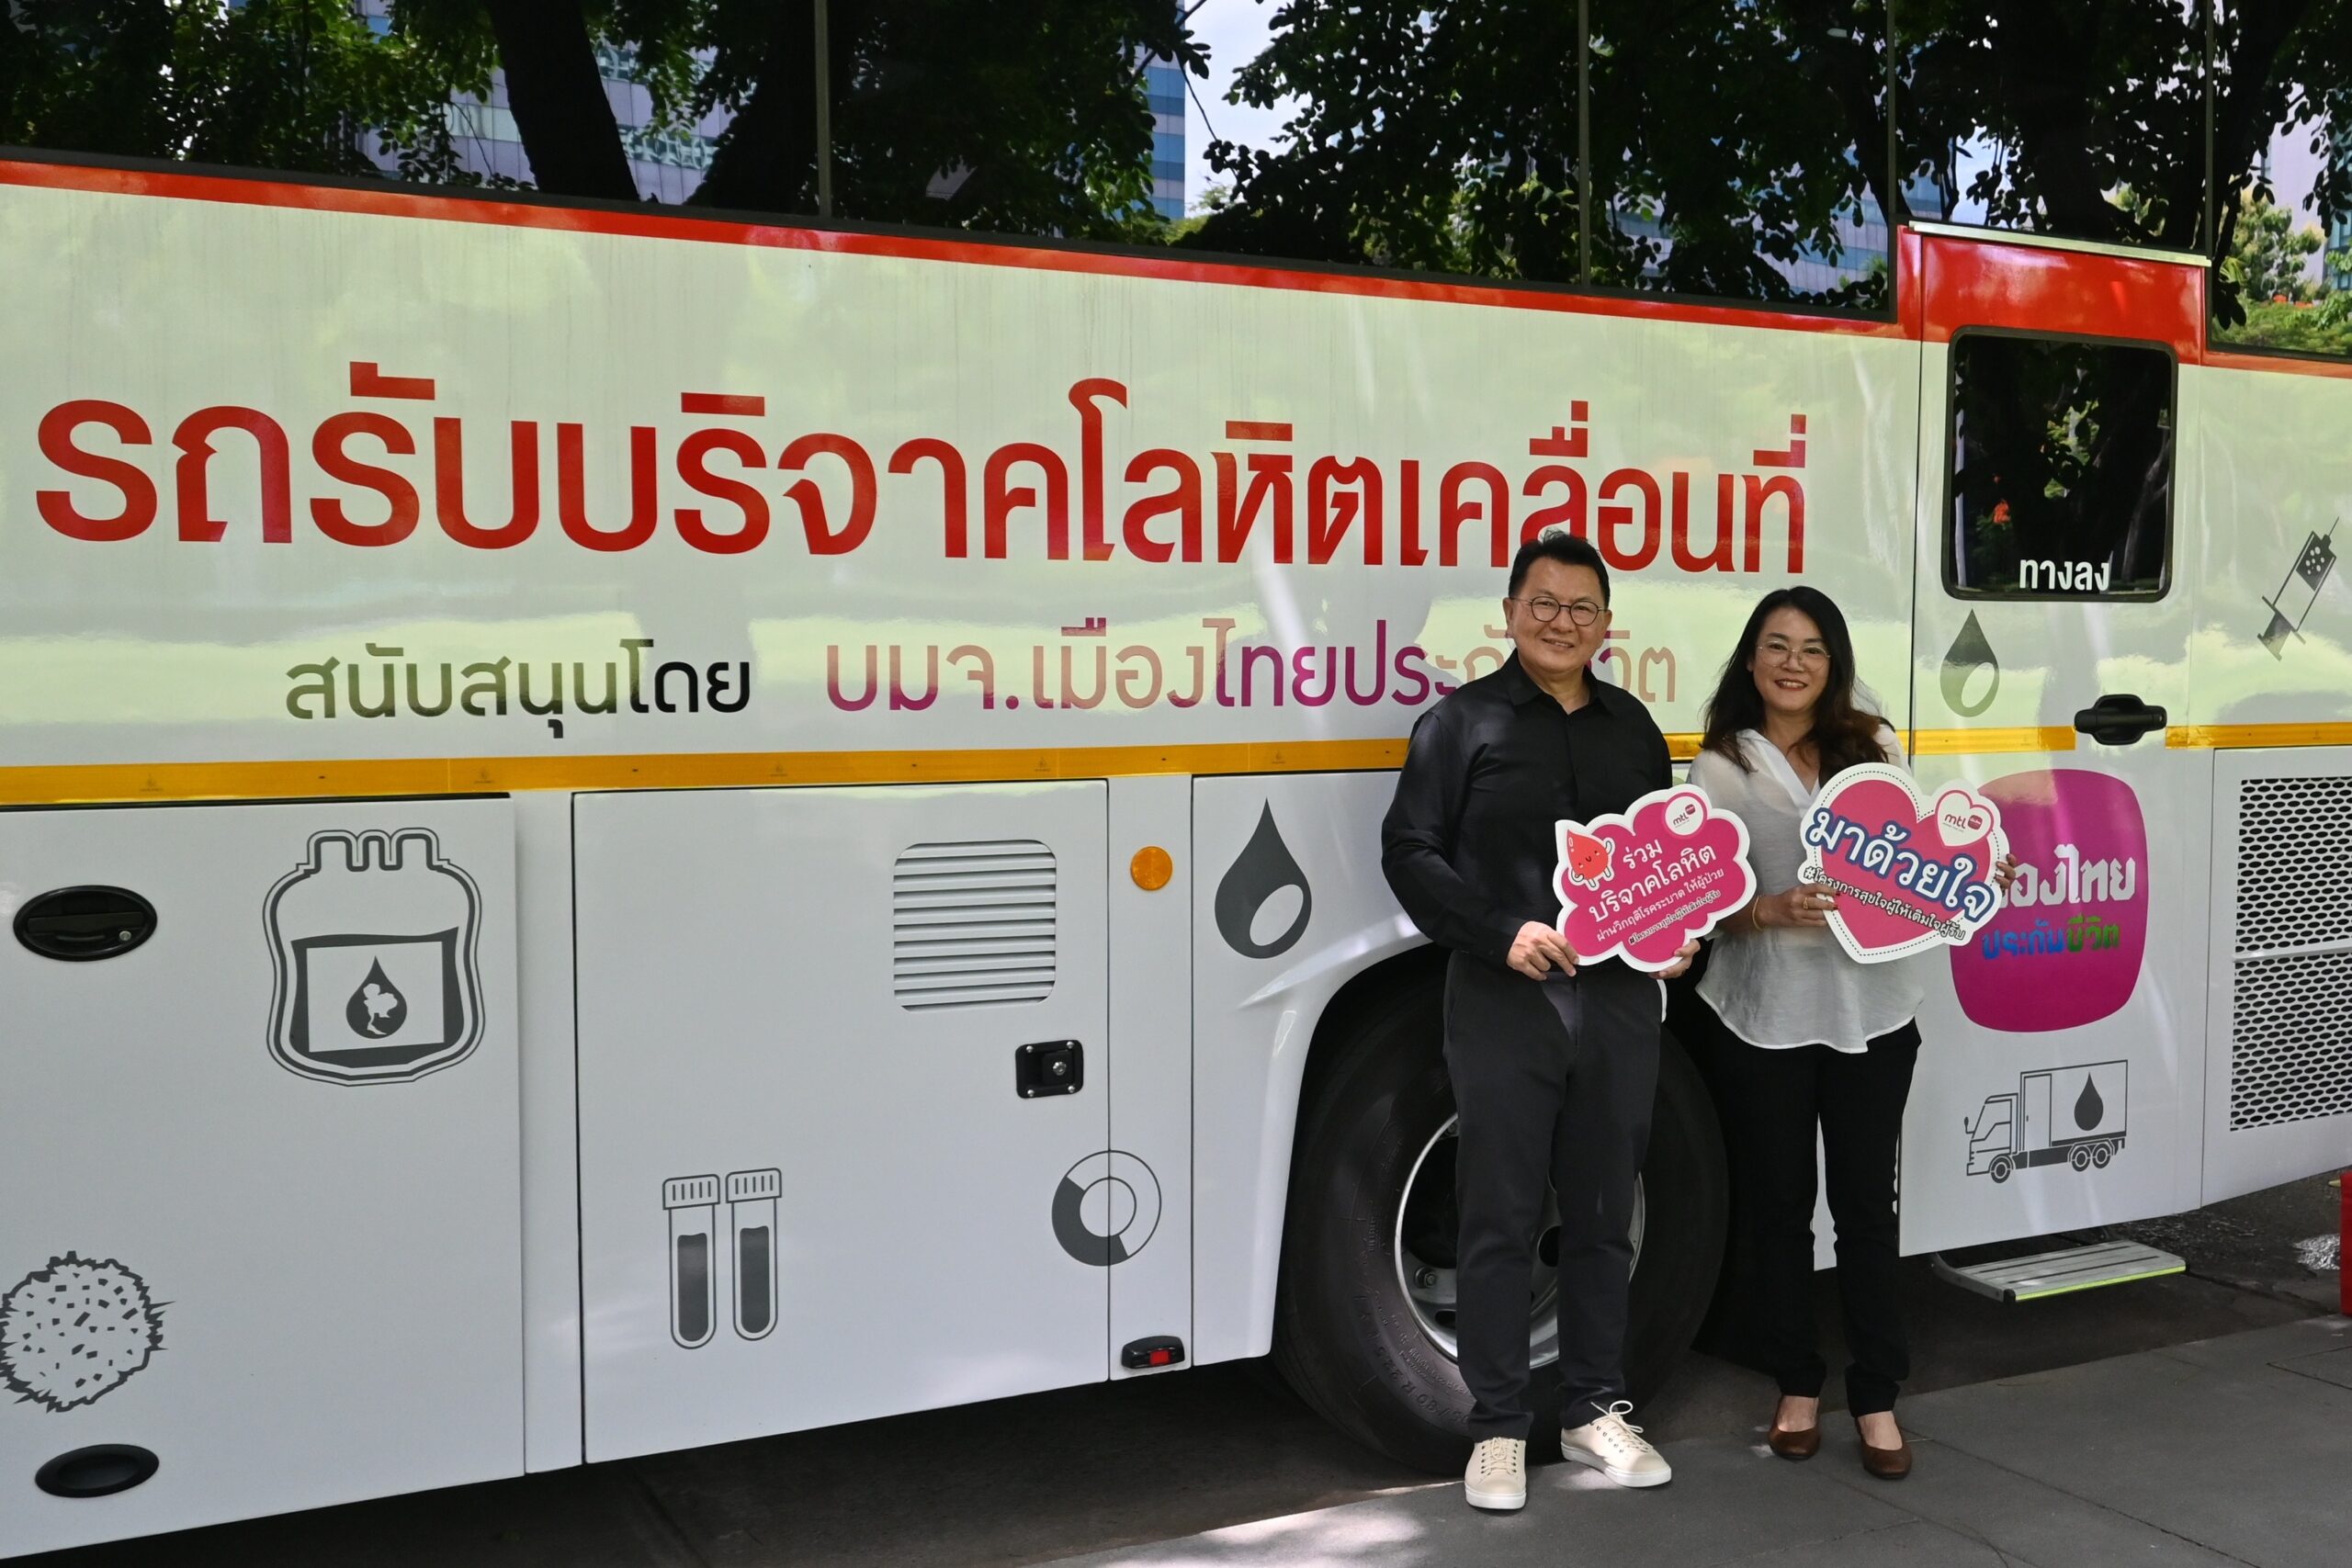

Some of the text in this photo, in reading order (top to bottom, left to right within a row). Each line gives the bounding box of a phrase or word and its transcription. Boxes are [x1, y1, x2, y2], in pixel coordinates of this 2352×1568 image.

[36, 361, 1807, 574] รถรับบริจาคโลหิตเคลื่อนที่
[2019, 558, 2110, 592] ทางลง
[286, 638, 751, 739] สนับสนุนโดย
[1672, 813, 1689, 827] mtl
[1943, 813, 1966, 829] mtl
[1623, 839, 1663, 869] ร่วม
[1806, 808, 1994, 921] มาด้วยใจ
[1589, 844, 1716, 922] บริจาคโลหิต
[1683, 868, 1724, 894] ให้ผู้ป่วย
